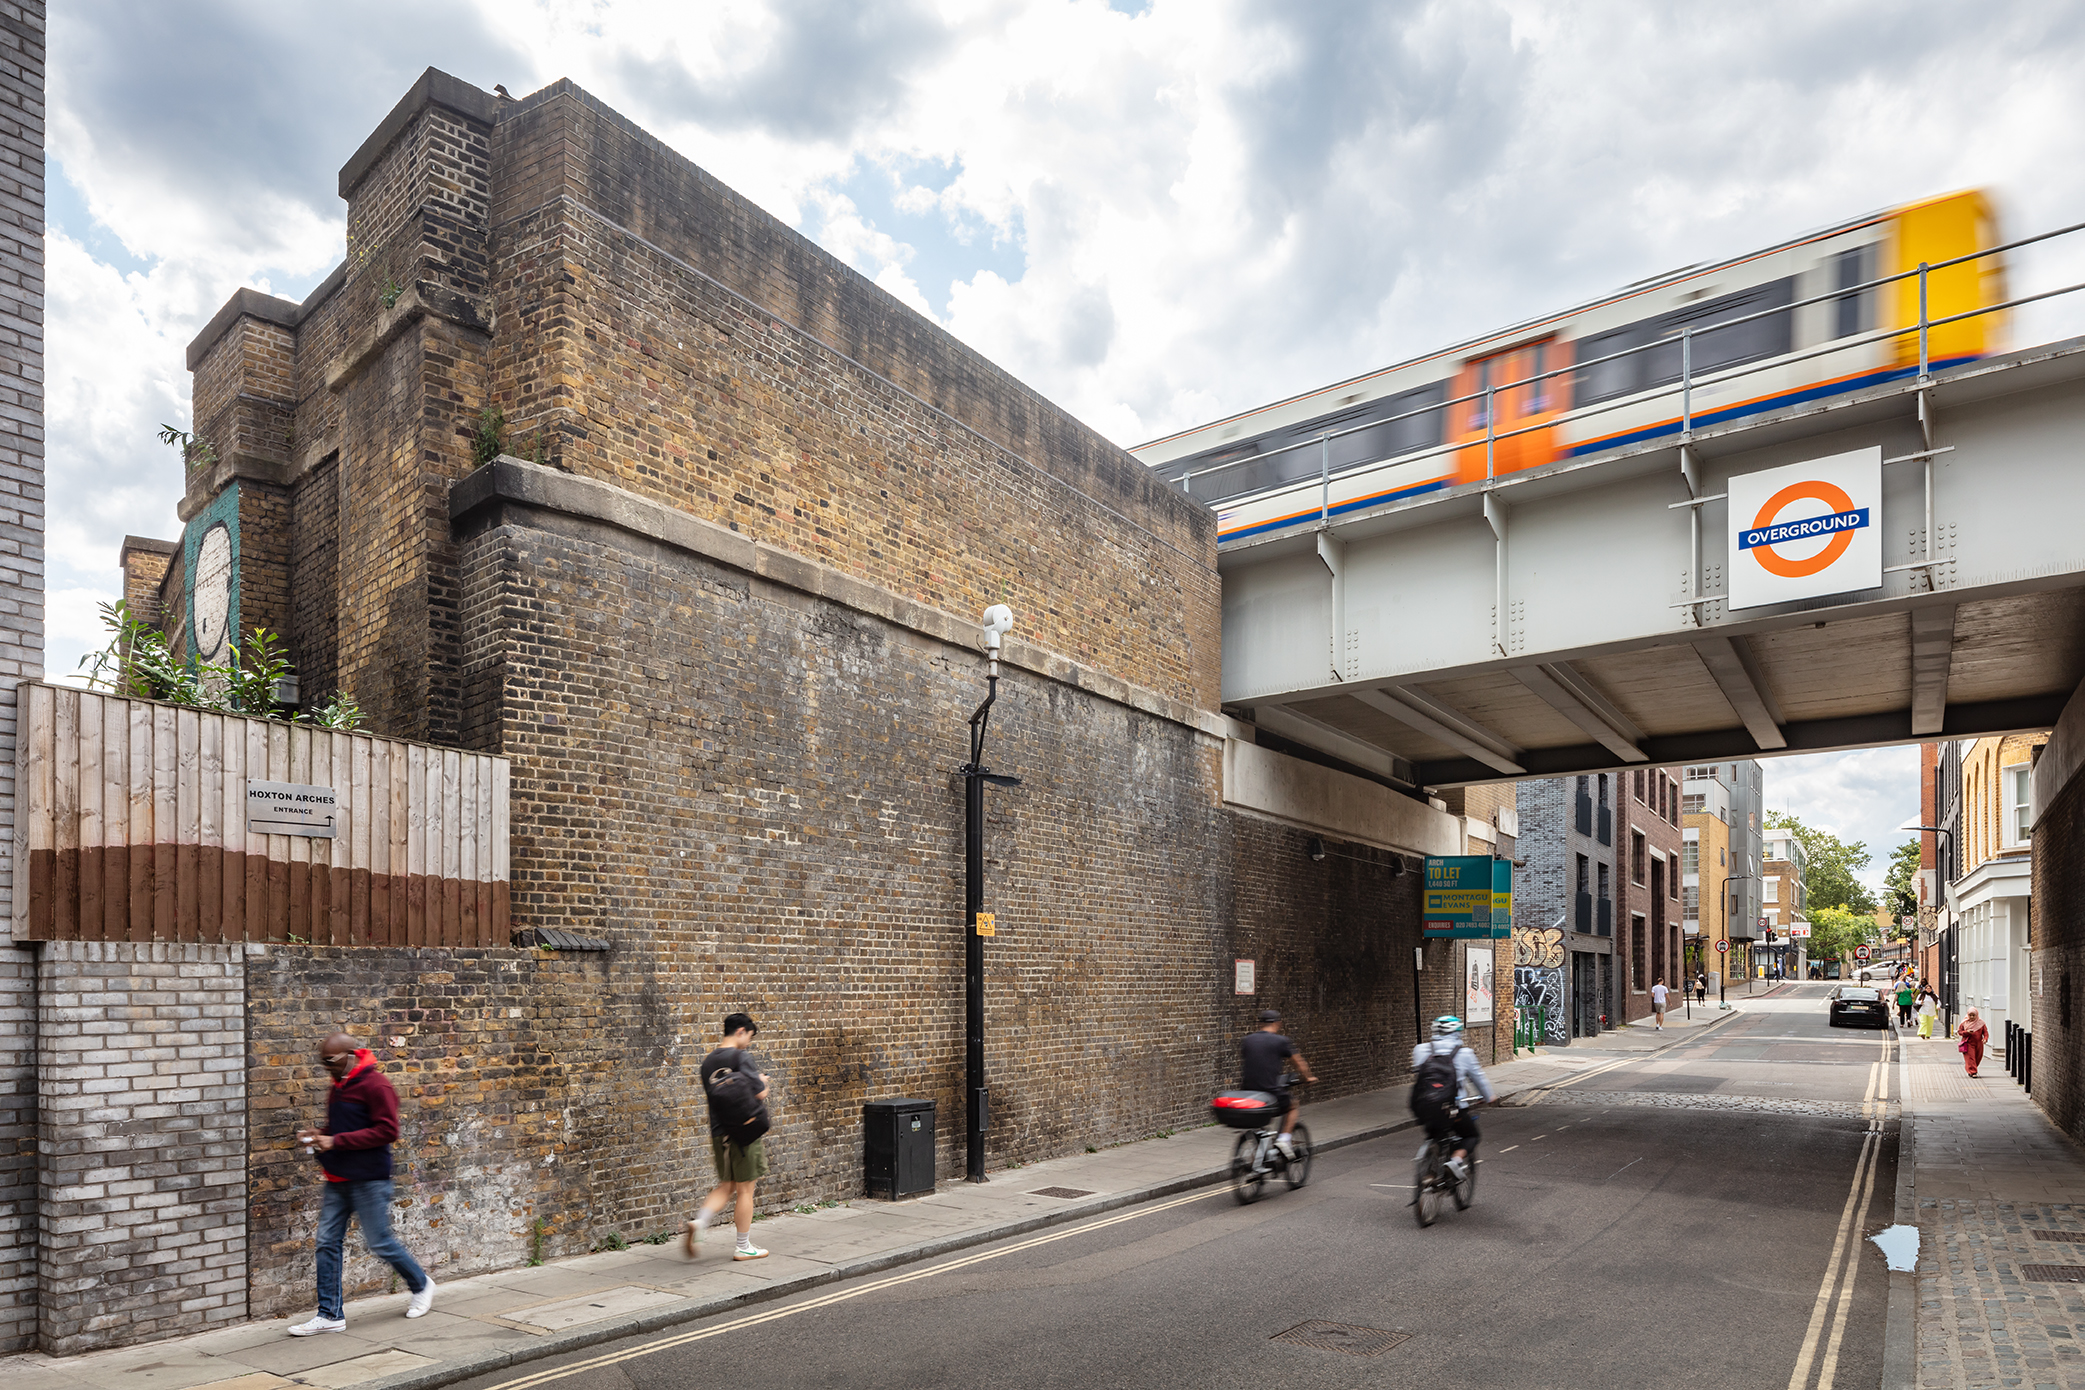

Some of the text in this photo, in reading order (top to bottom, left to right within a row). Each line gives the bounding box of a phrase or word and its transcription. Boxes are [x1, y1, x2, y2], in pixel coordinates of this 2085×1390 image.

[1747, 514, 1860, 545] OVERGROUND
[249, 790, 335, 804] HOXTON ARCHES
[273, 806, 313, 815] ENTRANCE
[1428, 867, 1461, 879] TO LET
